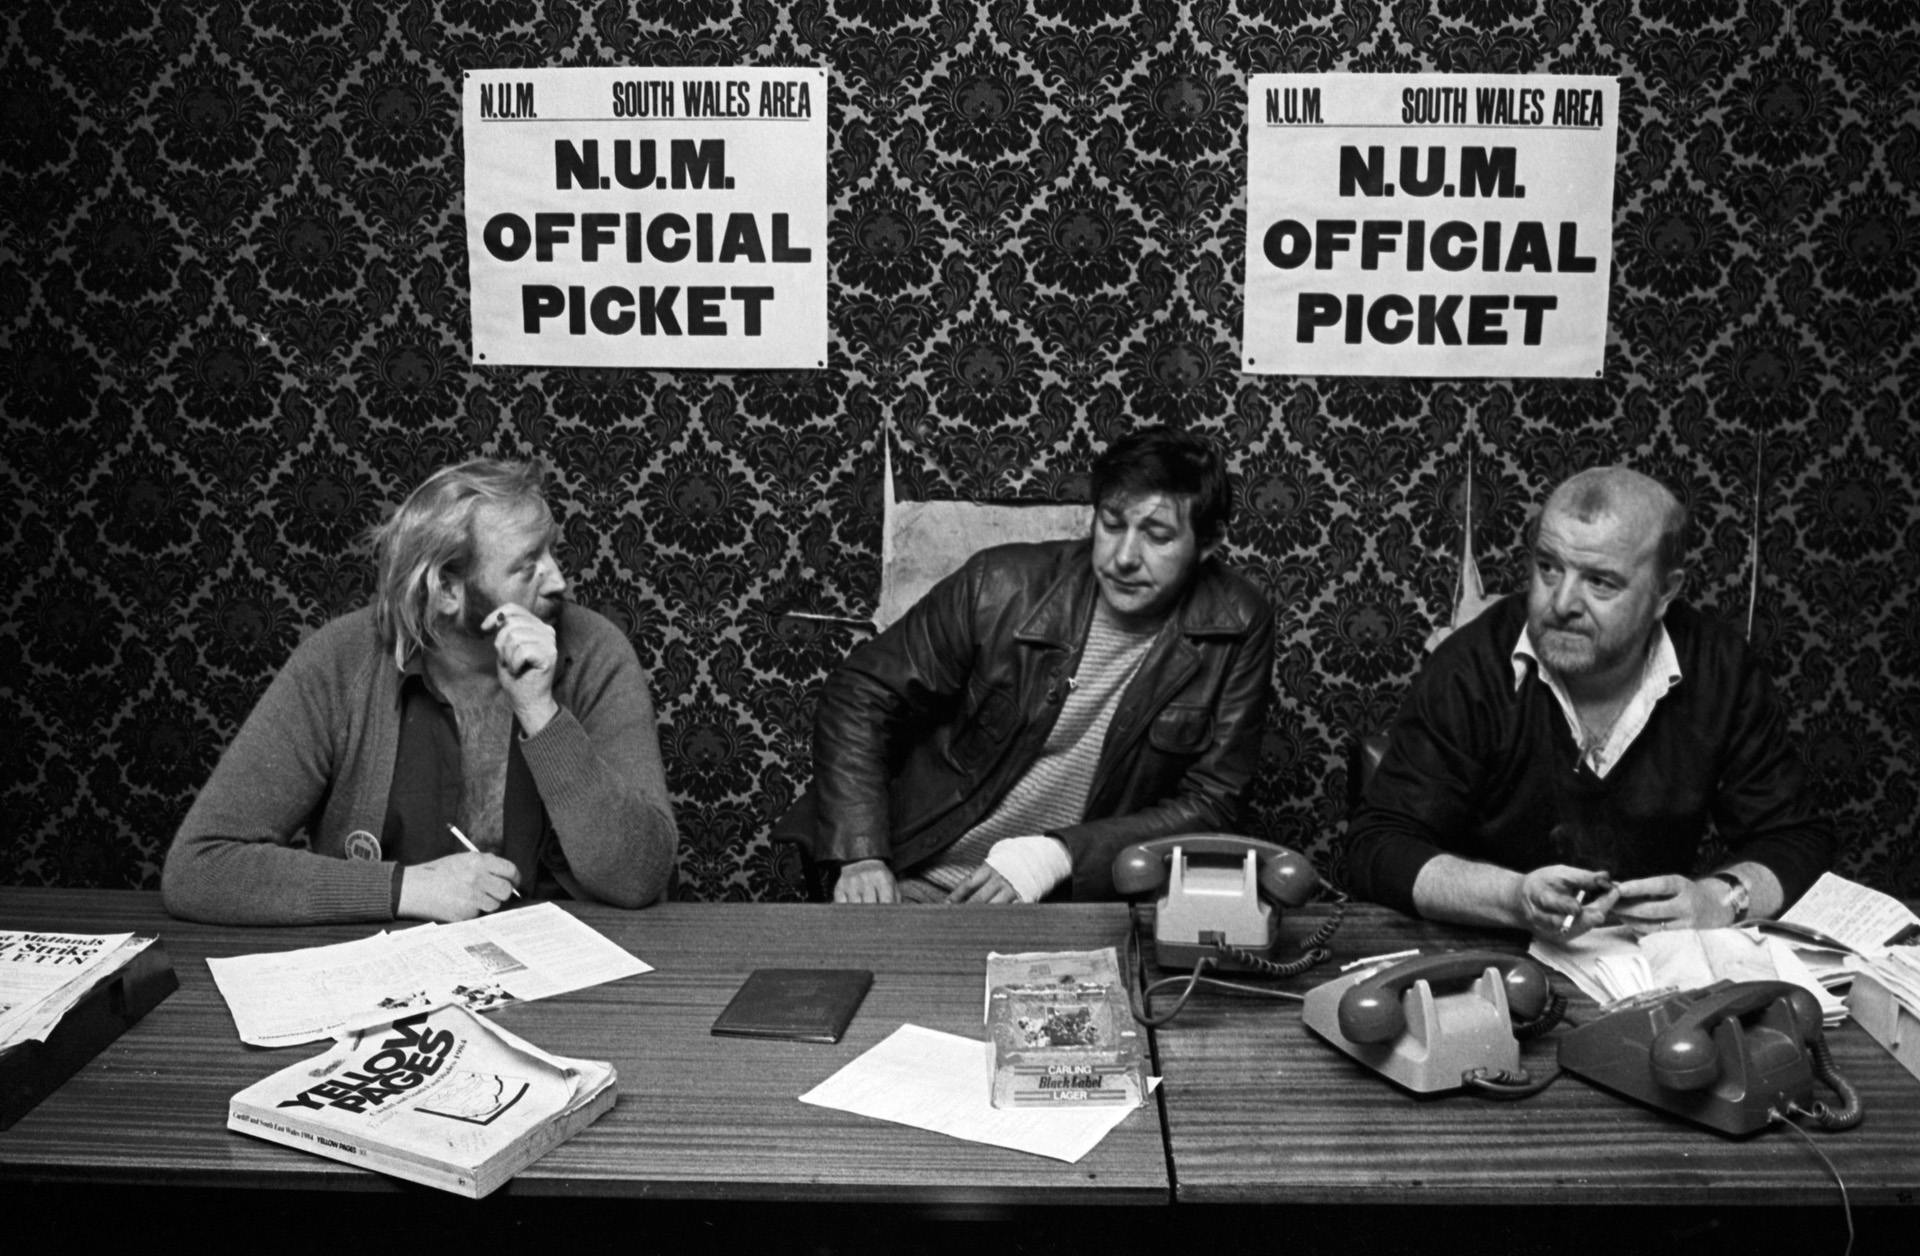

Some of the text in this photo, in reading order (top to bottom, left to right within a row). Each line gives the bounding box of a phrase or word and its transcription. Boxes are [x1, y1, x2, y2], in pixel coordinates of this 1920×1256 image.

[480, 83, 537, 118] N.U.M.
[612, 81, 811, 118] SOUTH WALES AREA
[1266, 87, 1324, 123] N.U.M.
[1401, 87, 1603, 126] SOUTH WALES AREA
[555, 138, 735, 190] N.U.M.
[1339, 145, 1525, 199] N.U.M.
[483, 212, 812, 263] OFFICIAL
[1263, 219, 1597, 273] OFFICIAL
[521, 284, 774, 336] PICKET
[1296, 292, 1558, 346] PICKET
[0, 952, 88, 964] ETIN
[276, 1011, 429, 1110] YELLOW
[328, 1027, 454, 1114] PAGES
[1048, 1065, 1092, 1075] CARLING
[1039, 1075, 1102, 1089] Black Label
[1053, 1090, 1088, 1101] LAGER
[316, 1135, 338, 1149] YELLOW
[339, 1142, 357, 1154] PAGES
